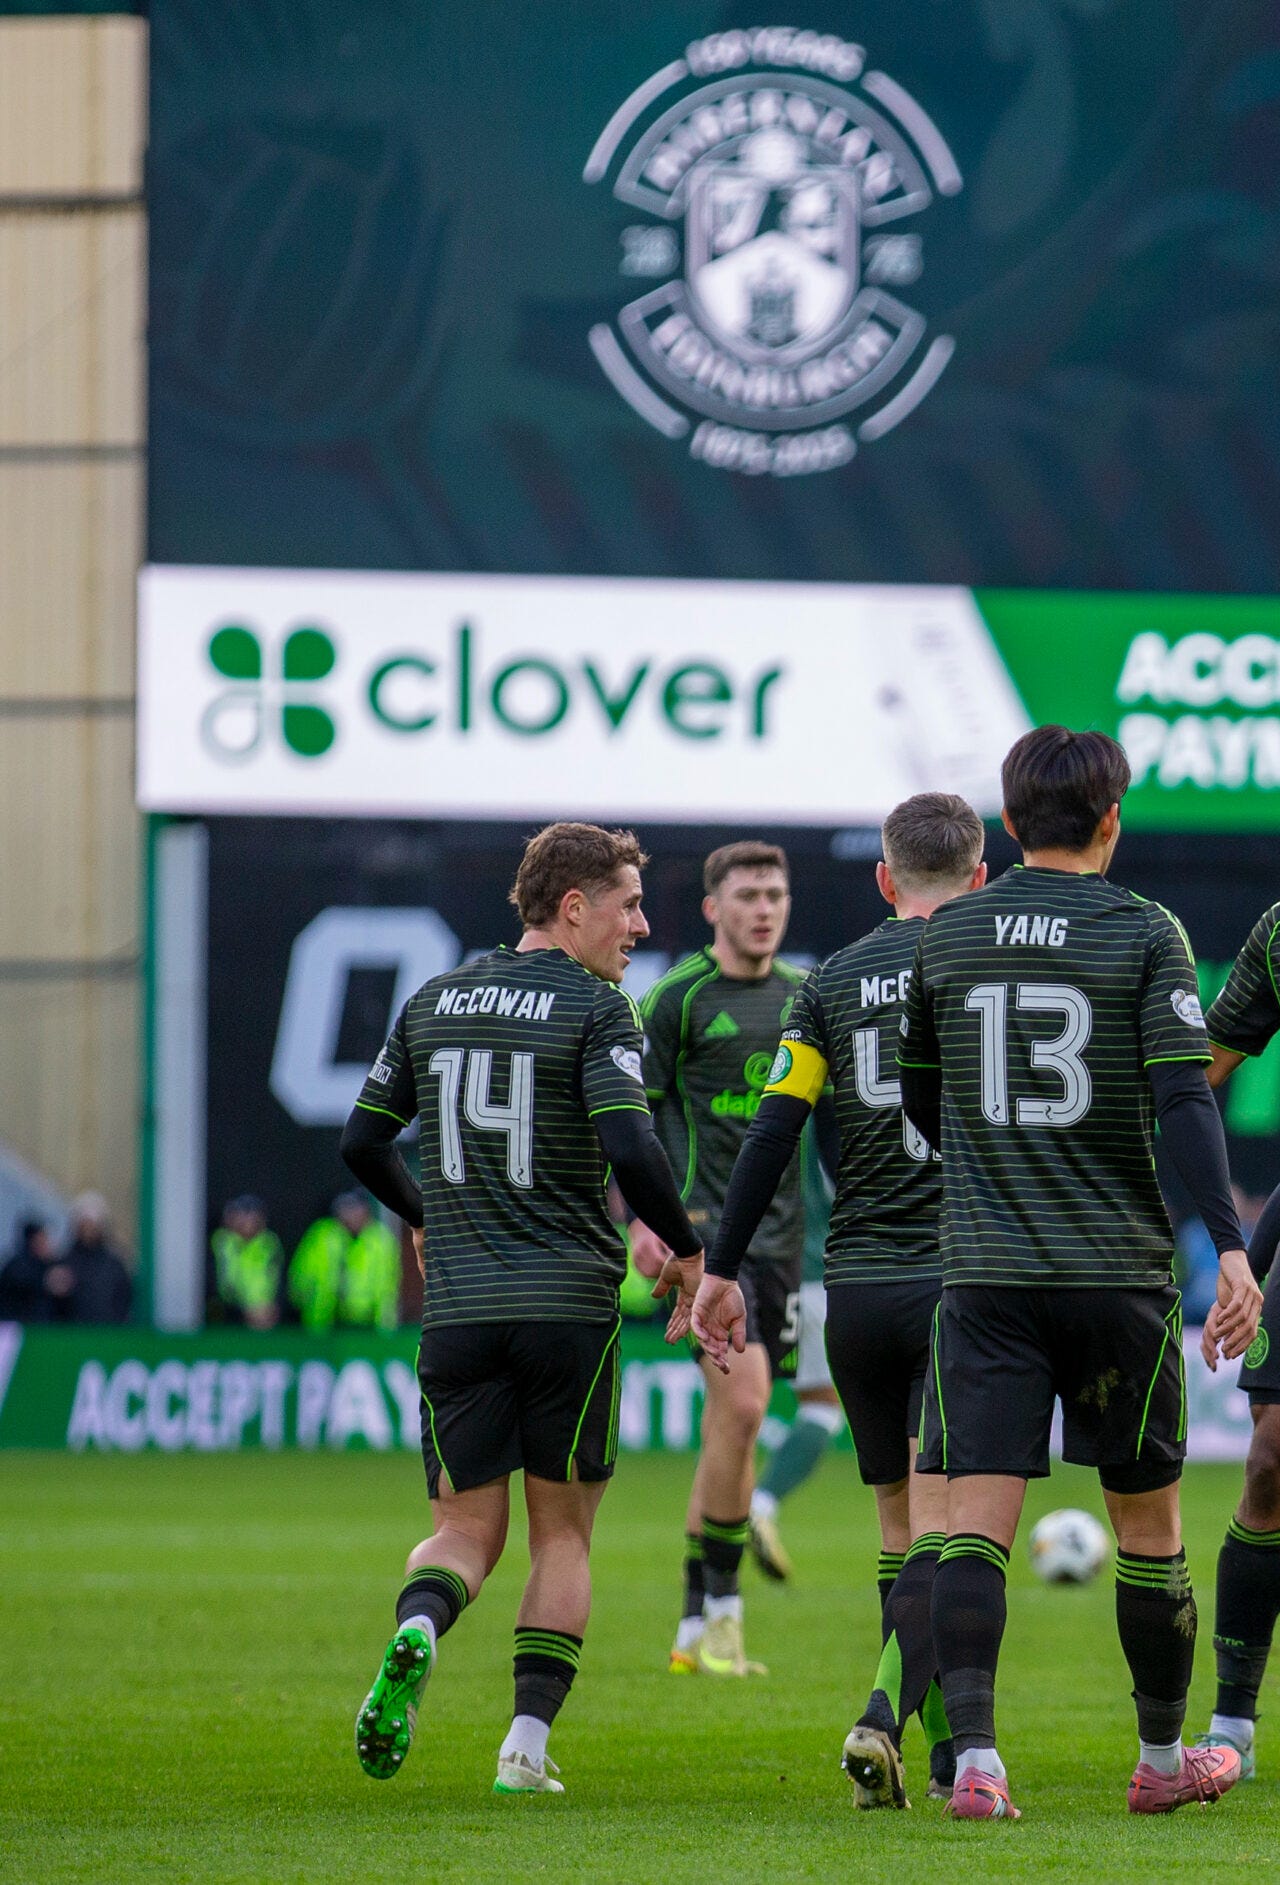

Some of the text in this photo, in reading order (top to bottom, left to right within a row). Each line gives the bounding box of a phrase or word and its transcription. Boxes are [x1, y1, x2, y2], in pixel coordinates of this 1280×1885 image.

[367, 619, 787, 740] clover
[994, 915, 1069, 947] YANG
[434, 986, 555, 1021] McCOWAN
[964, 983, 1093, 1127] 13
[429, 1047, 534, 1189] 14
[66, 1358, 293, 1450] ACCEPT
